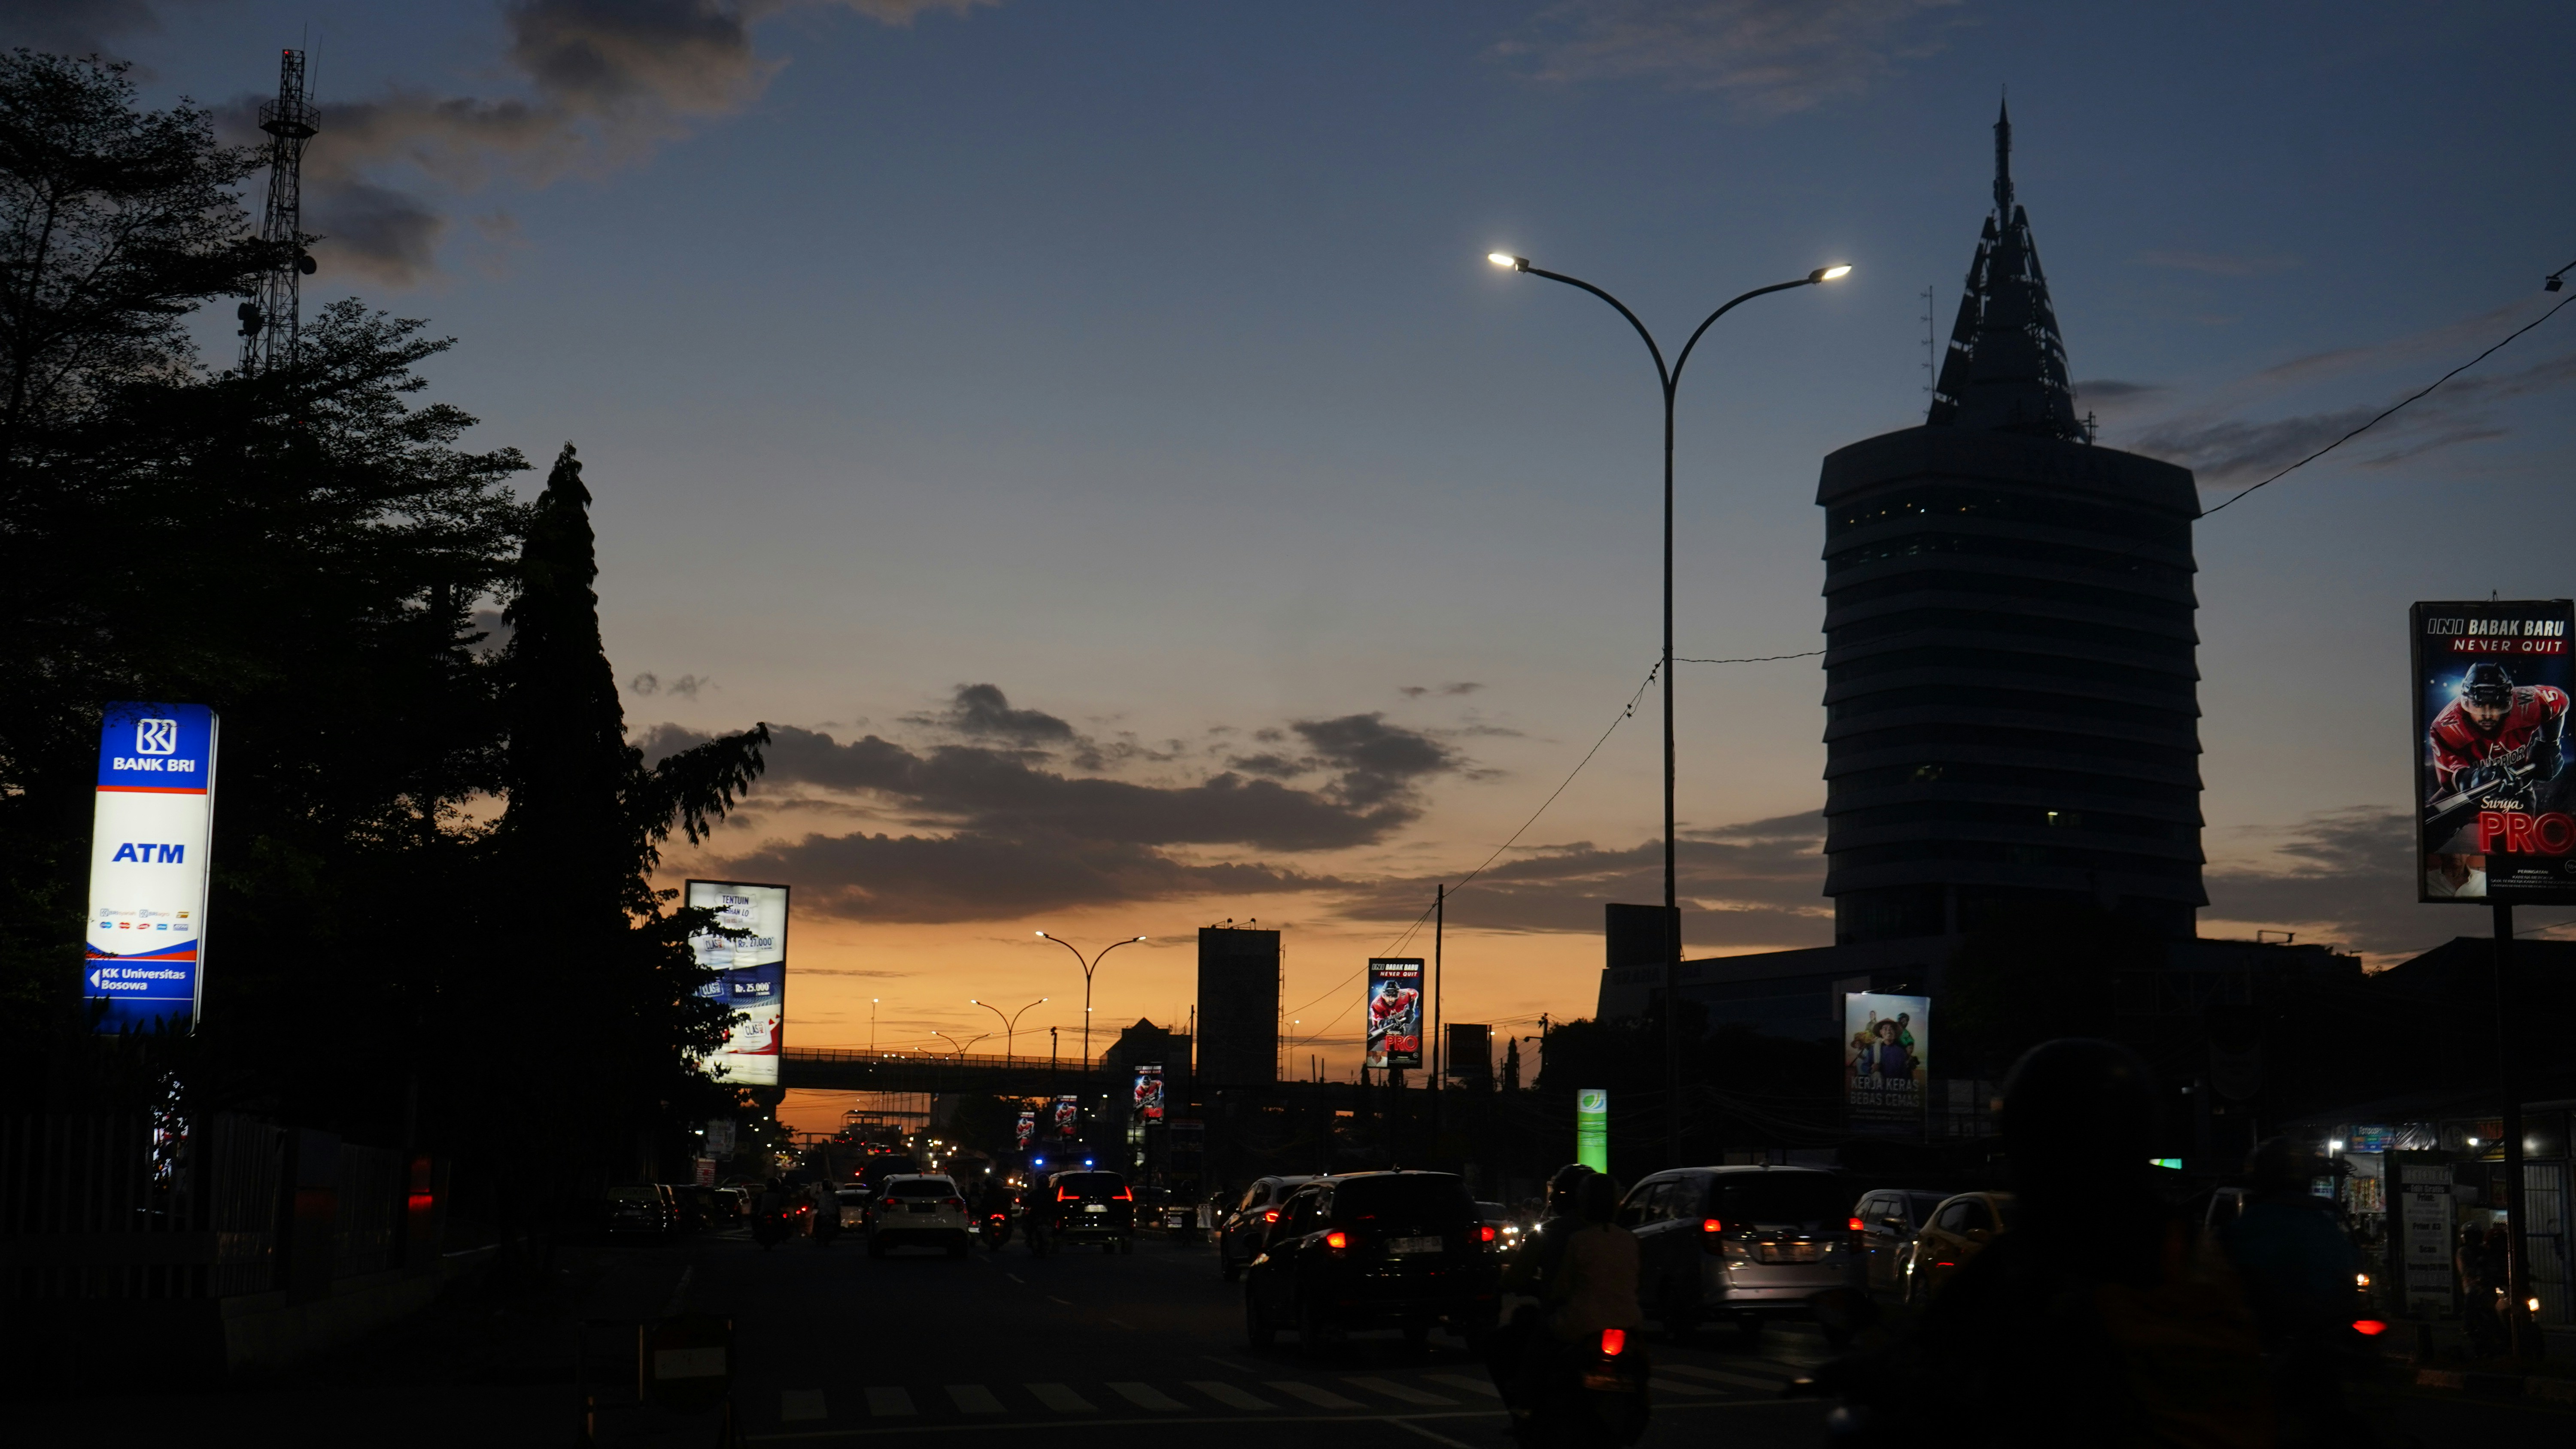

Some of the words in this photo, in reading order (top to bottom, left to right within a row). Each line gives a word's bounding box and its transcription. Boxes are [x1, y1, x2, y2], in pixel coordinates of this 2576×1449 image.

[2427, 618, 2464, 634] INI
[2468, 619, 2520, 636] BABAK
[2524, 620, 2564, 637] BARU
[2454, 639, 2511, 651] NEVER
[2521, 641, 2562, 652] QUIT
[113, 757, 164, 771] BANK
[167, 759, 195, 772] BRI
[2480, 795, 2524, 814] Surya
[2479, 810, 2576, 854] PRO
[112, 843, 185, 864] ATM
[723, 895, 749, 905] TENTUIN
[102, 968, 119, 978] KK
[122, 968, 185, 979] Universitas
[101, 979, 147, 990] Bosowa
[1385, 1035, 1419, 1052] PRO
[1851, 1076, 1883, 1090] KERJA
[1886, 1078, 1919, 1091] KERAS
[1850, 1091, 1883, 1105] BEBAS
[1885, 1093, 1920, 1107] CEMAS
